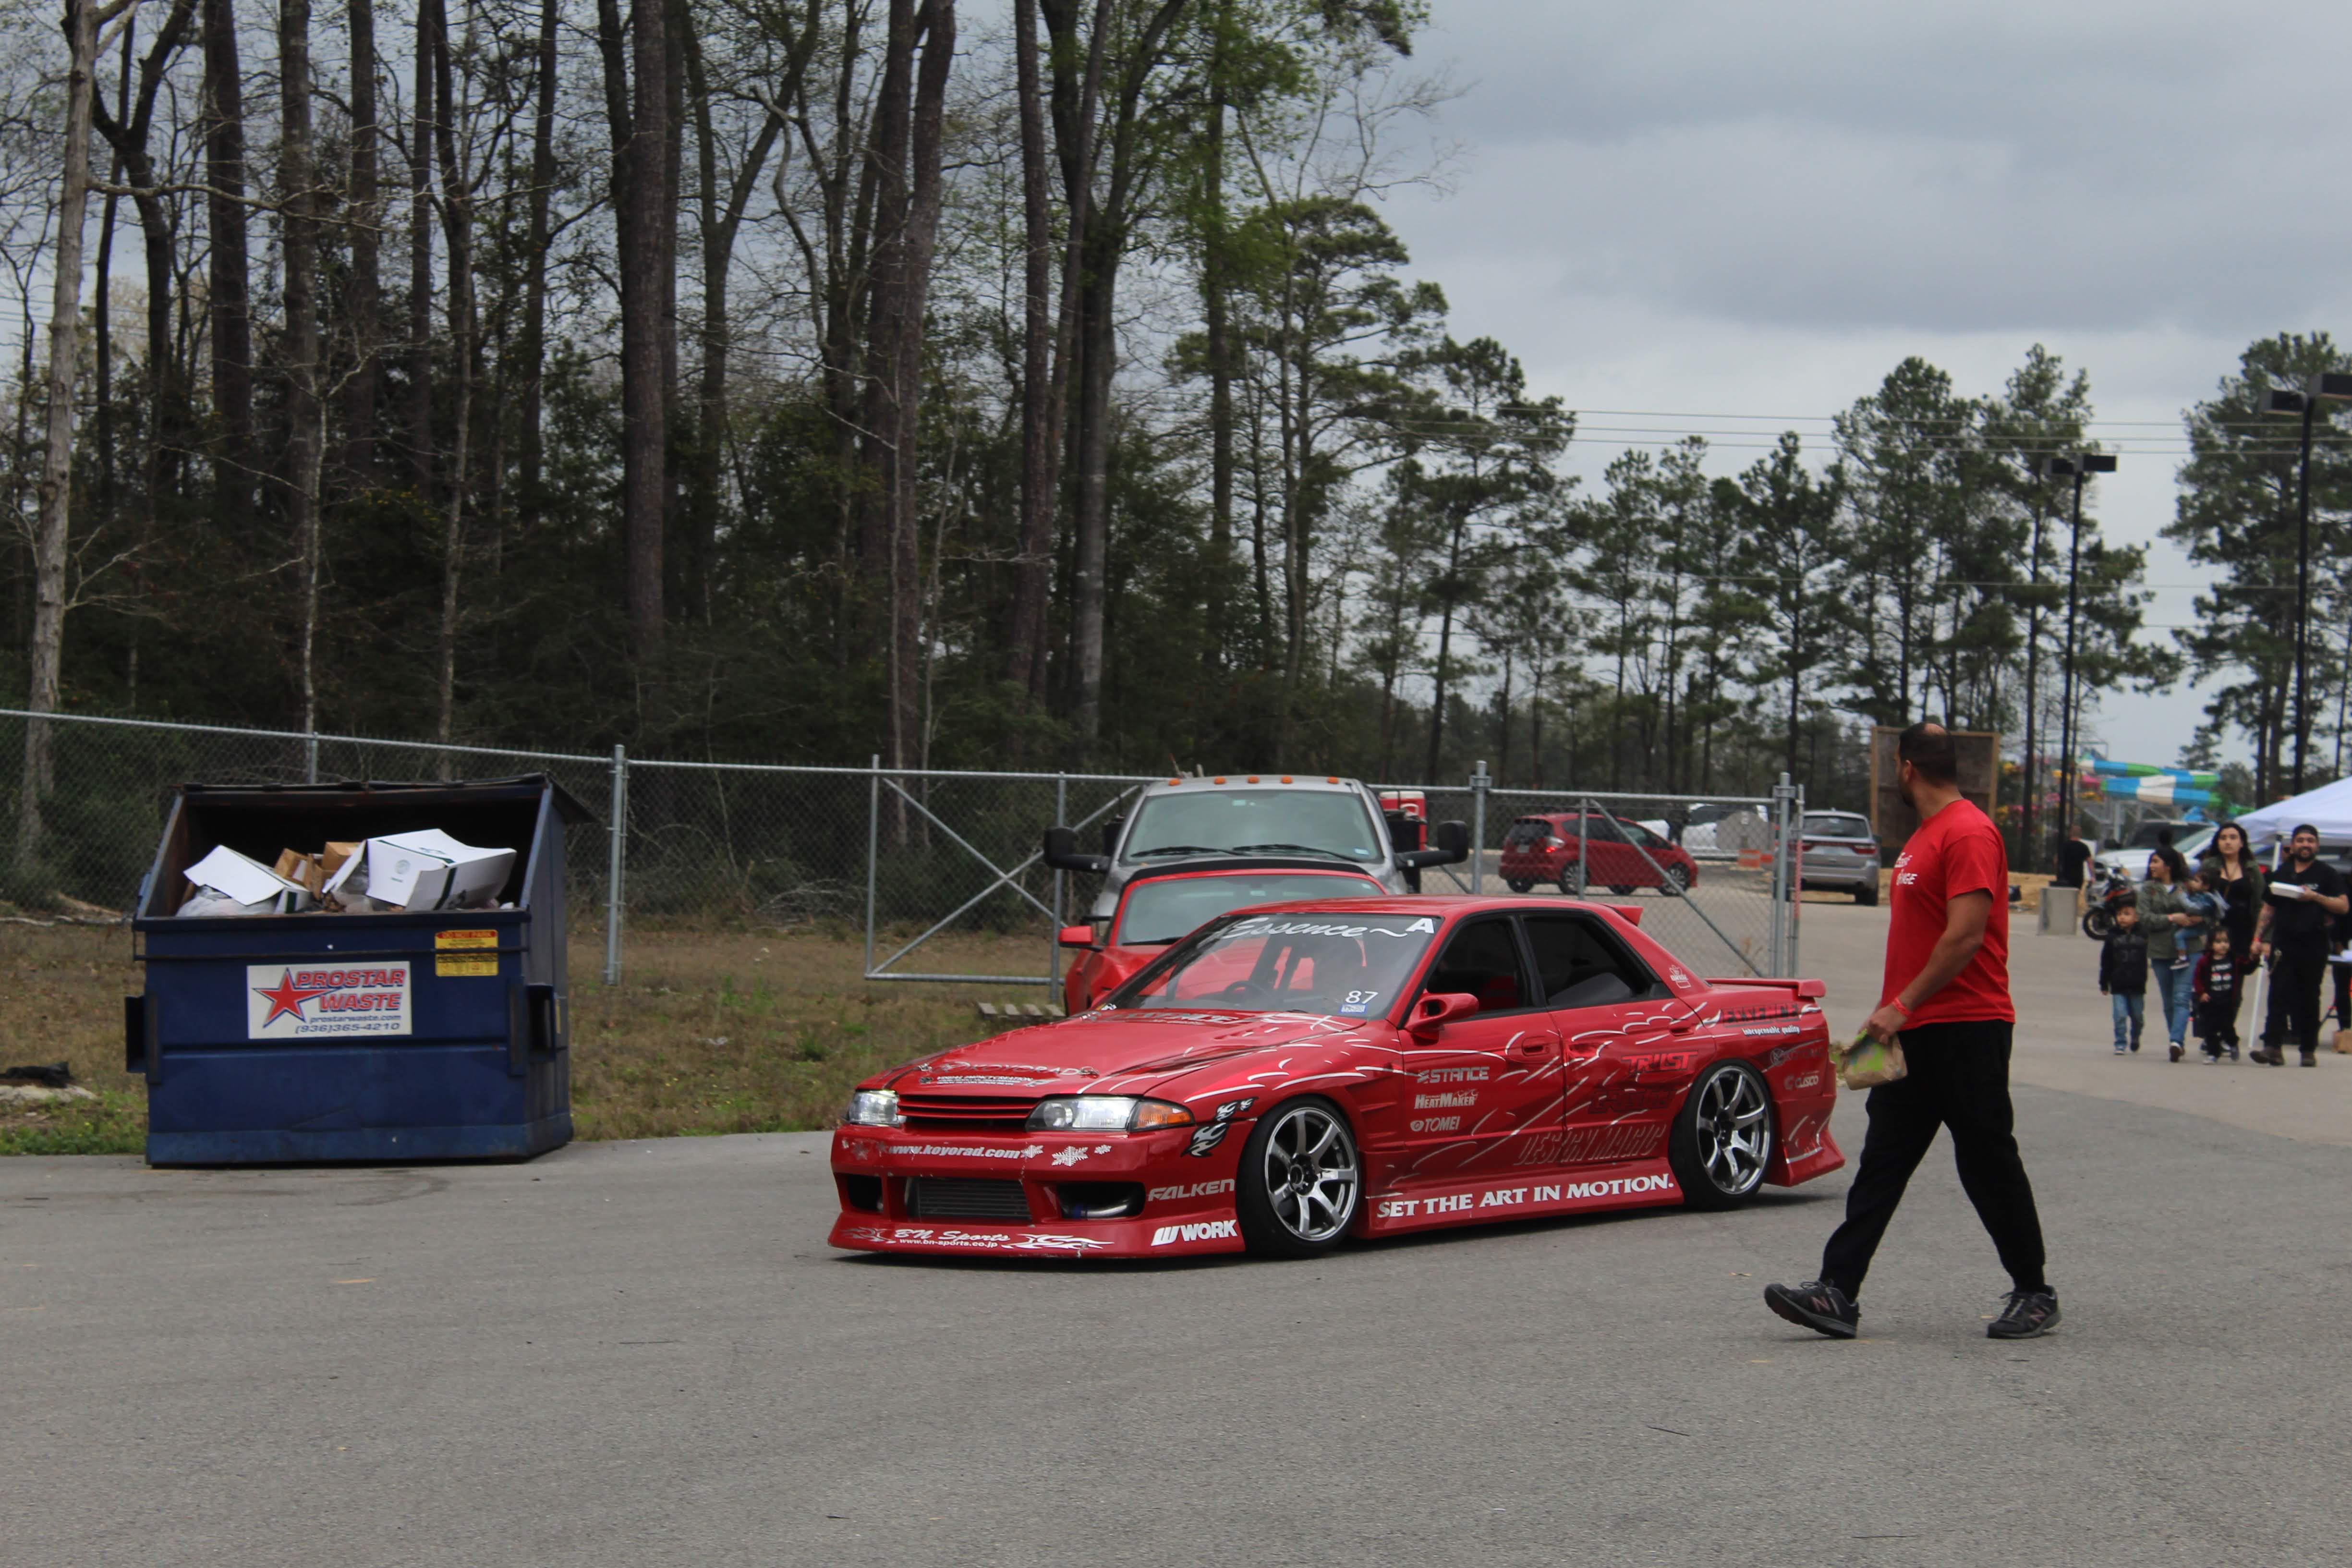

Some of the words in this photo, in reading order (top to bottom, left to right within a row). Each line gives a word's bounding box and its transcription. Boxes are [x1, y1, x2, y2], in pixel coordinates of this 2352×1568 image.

[1222, 917, 1368, 939] Essence
[295, 969, 406, 988] PROSTAR
[319, 992, 402, 1012] WASTE
[1346, 990, 1379, 1004] 87
[309, 1015, 401, 1024] prostarwaste.com
[295, 1023, 400, 1034] (936)365-4210
[1621, 1051, 1698, 1074] TRUST
[1430, 1066, 1490, 1083] STANCE
[1425, 1116, 1460, 1132] TOMEI
[889, 1144, 1021, 1159] www.koyorad.com
[1148, 1179, 1235, 1202] FALKEN
[1377, 1200, 1419, 1218] SET
[1423, 1193, 1473, 1214] THE
[1479, 1188, 1528, 1207] ART
[1533, 1185, 1560, 1202] IN
[1566, 1173, 1674, 1199] MOTION.
[895, 1228, 934, 1240] BN
[938, 1230, 1010, 1242] Sports
[1180, 1219, 1238, 1241] WORK
[899, 1238, 998, 1249] www.bn-sports.co.jp
